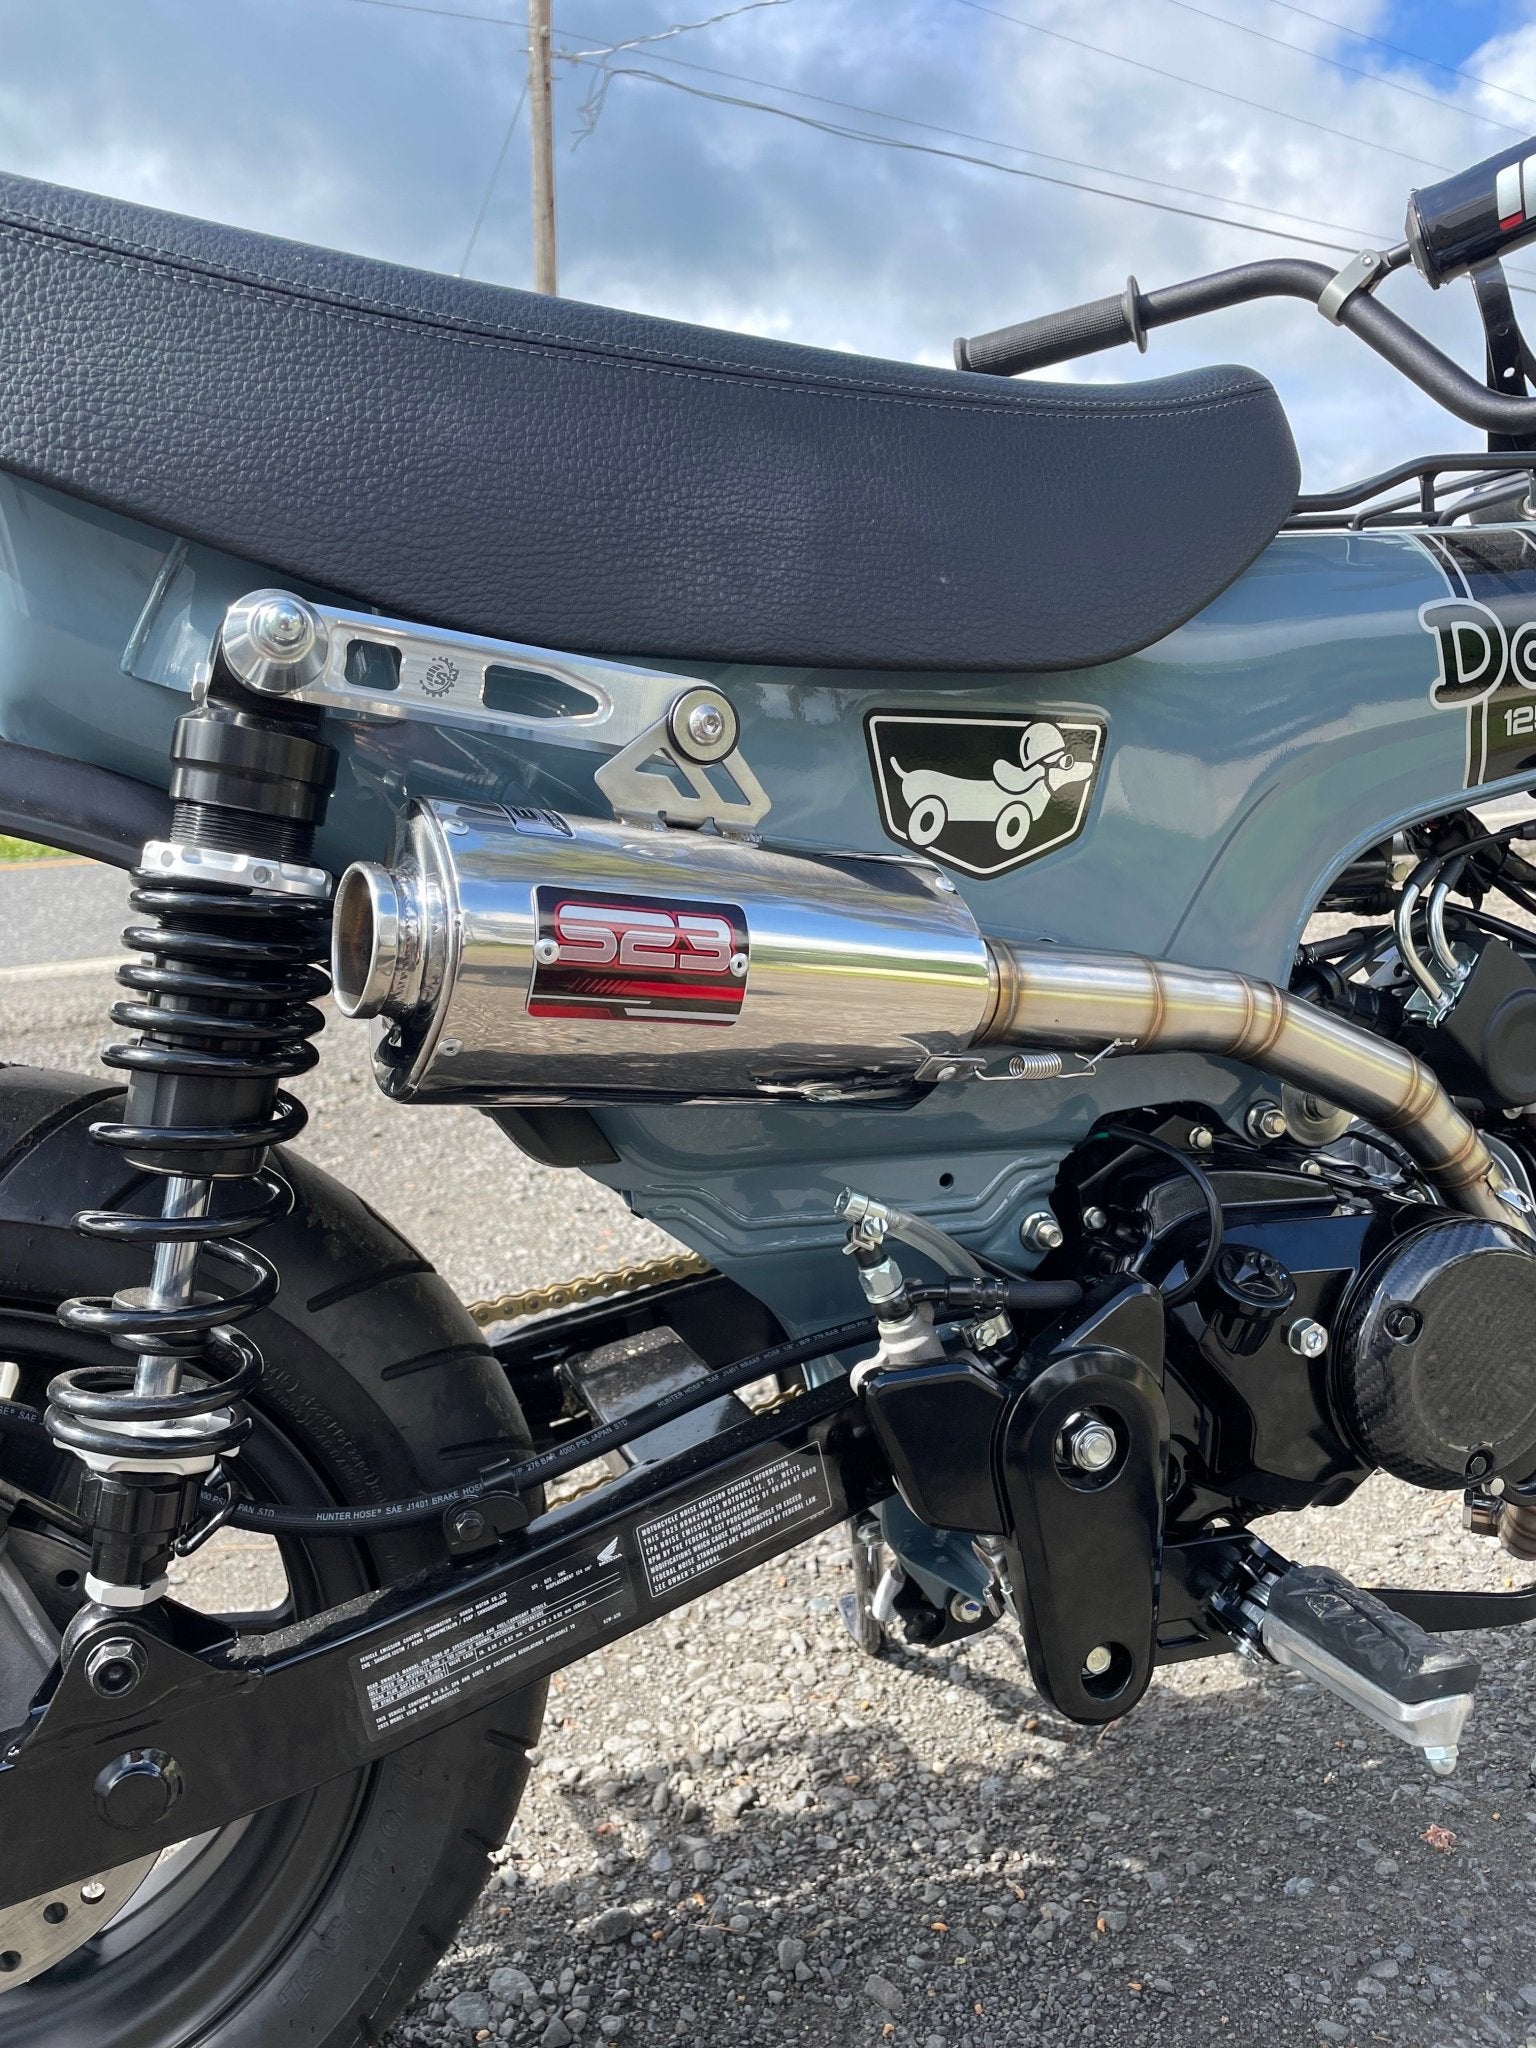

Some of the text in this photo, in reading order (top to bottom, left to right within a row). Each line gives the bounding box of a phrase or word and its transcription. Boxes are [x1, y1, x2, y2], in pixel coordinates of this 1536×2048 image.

[1503, 705, 1536, 737] 12
[558, 903, 733, 973] S23
[18, 1410, 37, 1423] SAE
[526, 1461, 541, 1472] 276
[540, 1451, 557, 1466] BAR
[559, 1444, 576, 1457] 4000
[576, 1437, 590, 1449] PSI
[591, 1421, 613, 1443] JAPAN
[613, 1418, 629, 1431] STD
[257, 1507, 275, 1518] STD
[316, 1511, 351, 1521] HUNTER
[353, 1508, 382, 1519] HOSE®
[386, 1503, 403, 1516] SAE
[406, 1498, 429, 1512] J1401
[431, 1490, 461, 1506] BRAKE
[641, 1513, 679, 1537] MOTORCYCLE
[679, 1504, 697, 1519] NOISE
[698, 1490, 726, 1509] EMISSION
[727, 1478, 752, 1496] CONTROL
[643, 1533, 659, 1546] THIS
[661, 1524, 678, 1538] 2025
[781, 1464, 801, 1479] MEETS
[645, 1544, 658, 1556] EPA
[660, 1533, 680, 1549] NOISE
[681, 1517, 712, 1538] EMISSION
[714, 1494, 760, 1522] REQUIREMENTS
[762, 1489, 770, 1499] OF
[793, 1474, 800, 1483] AT
[648, 1553, 661, 1565] RPM
[663, 1548, 671, 1557] BY
[672, 1542, 683, 1553] THE
[685, 1529, 710, 1546] FEDERAL
[711, 1521, 725, 1533] TEST
[650, 1493, 802, 1574] MODIFICATIONS WHICH CAUSE THIS MOTORCYCLE TO EXCEED
[652, 1565, 677, 1583] FEDERAL
[677, 1556, 695, 1571] NOISE
[696, 1540, 728, 1561] STANDARDS
[728, 1534, 739, 1545] ARE
[740, 1517, 773, 1539] PROHIBITED
[774, 1513, 781, 1523] BY
[782, 1502, 804, 1518] FEDERAL
[545, 1573, 574, 1590] DISPLACEMENT
[654, 1581, 666, 1593] SEE
[667, 1567, 695, 1586] OWNER'S
[360, 1651, 378, 1663] VEHICLE
[380, 1640, 401, 1654] EMISSION
[402, 1631, 421, 1644] CONTROL
[424, 1617, 452, 1634] INFORMATION
[459, 1607, 473, 1617] HONDA
[475, 1600, 489, 1610] MOTOR
[367, 1682, 378, 1691] READ
[402, 1663, 419, 1674] MANUAL
[421, 1657, 429, 1665] FOR
[452, 1632, 484, 1651] SPECIFICATIONS
[486, 1627, 495, 1635] AND
[376, 1715, 387, 1724] THIS
[388, 1705, 406, 1718] VEHICLE
[408, 1693, 431, 1708] CONFORMS
[451, 1680, 459, 1688] EPA
[461, 1674, 470, 1683] AND
[472, 1668, 484, 1677] STATE
[493, 1652, 516, 1667] CALIFORNIA
[518, 1639, 544, 1655] REGULATIONS
[545, 1627, 568, 1642] APPLICABLE
[377, 1720, 389, 1730] 2025
[389, 1713, 404, 1724] MODEL
[406, 1707, 417, 1716] YEAR
[419, 1701, 429, 1710] NEW
